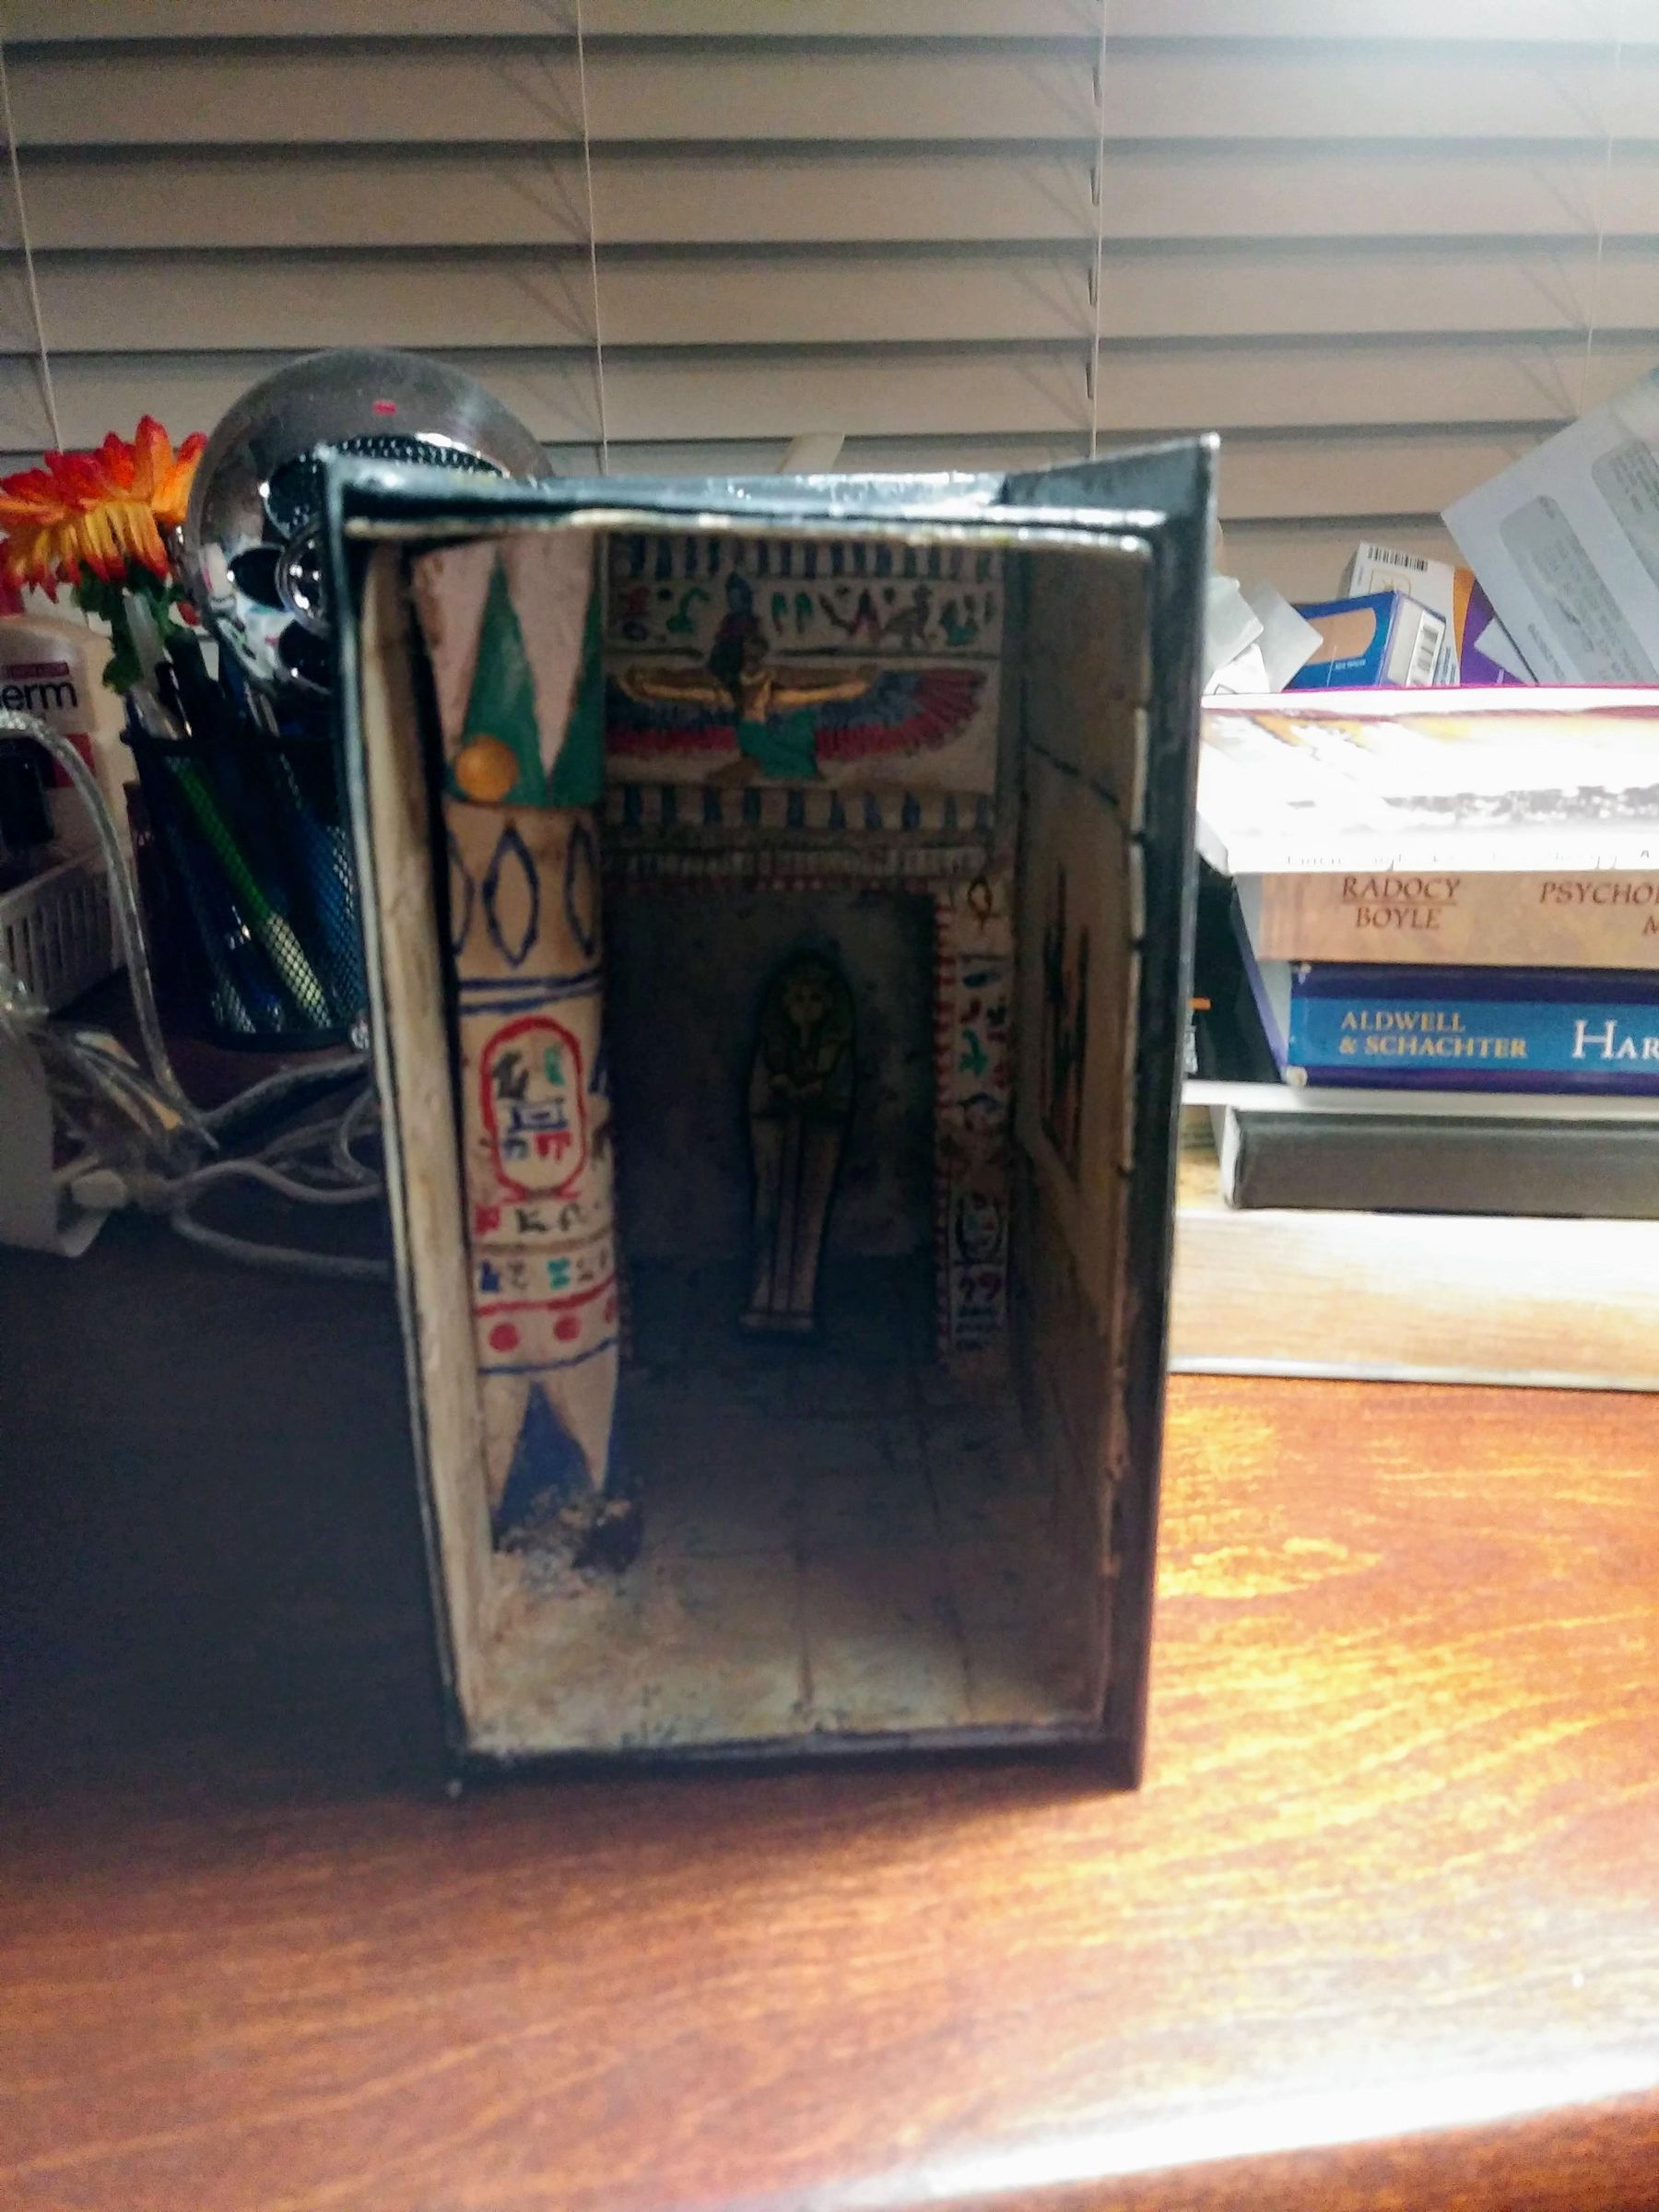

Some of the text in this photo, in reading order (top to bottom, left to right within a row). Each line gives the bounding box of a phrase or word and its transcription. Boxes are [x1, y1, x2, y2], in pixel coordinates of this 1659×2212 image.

[0, 682, 78, 711] erm
[1342, 876, 1461, 899] RADOCY
[1355, 906, 1441, 929] BOYLE
[1340, 1010, 1466, 1032] ALDWELL
[1339, 1034, 1527, 1059] & SCHACHTER
